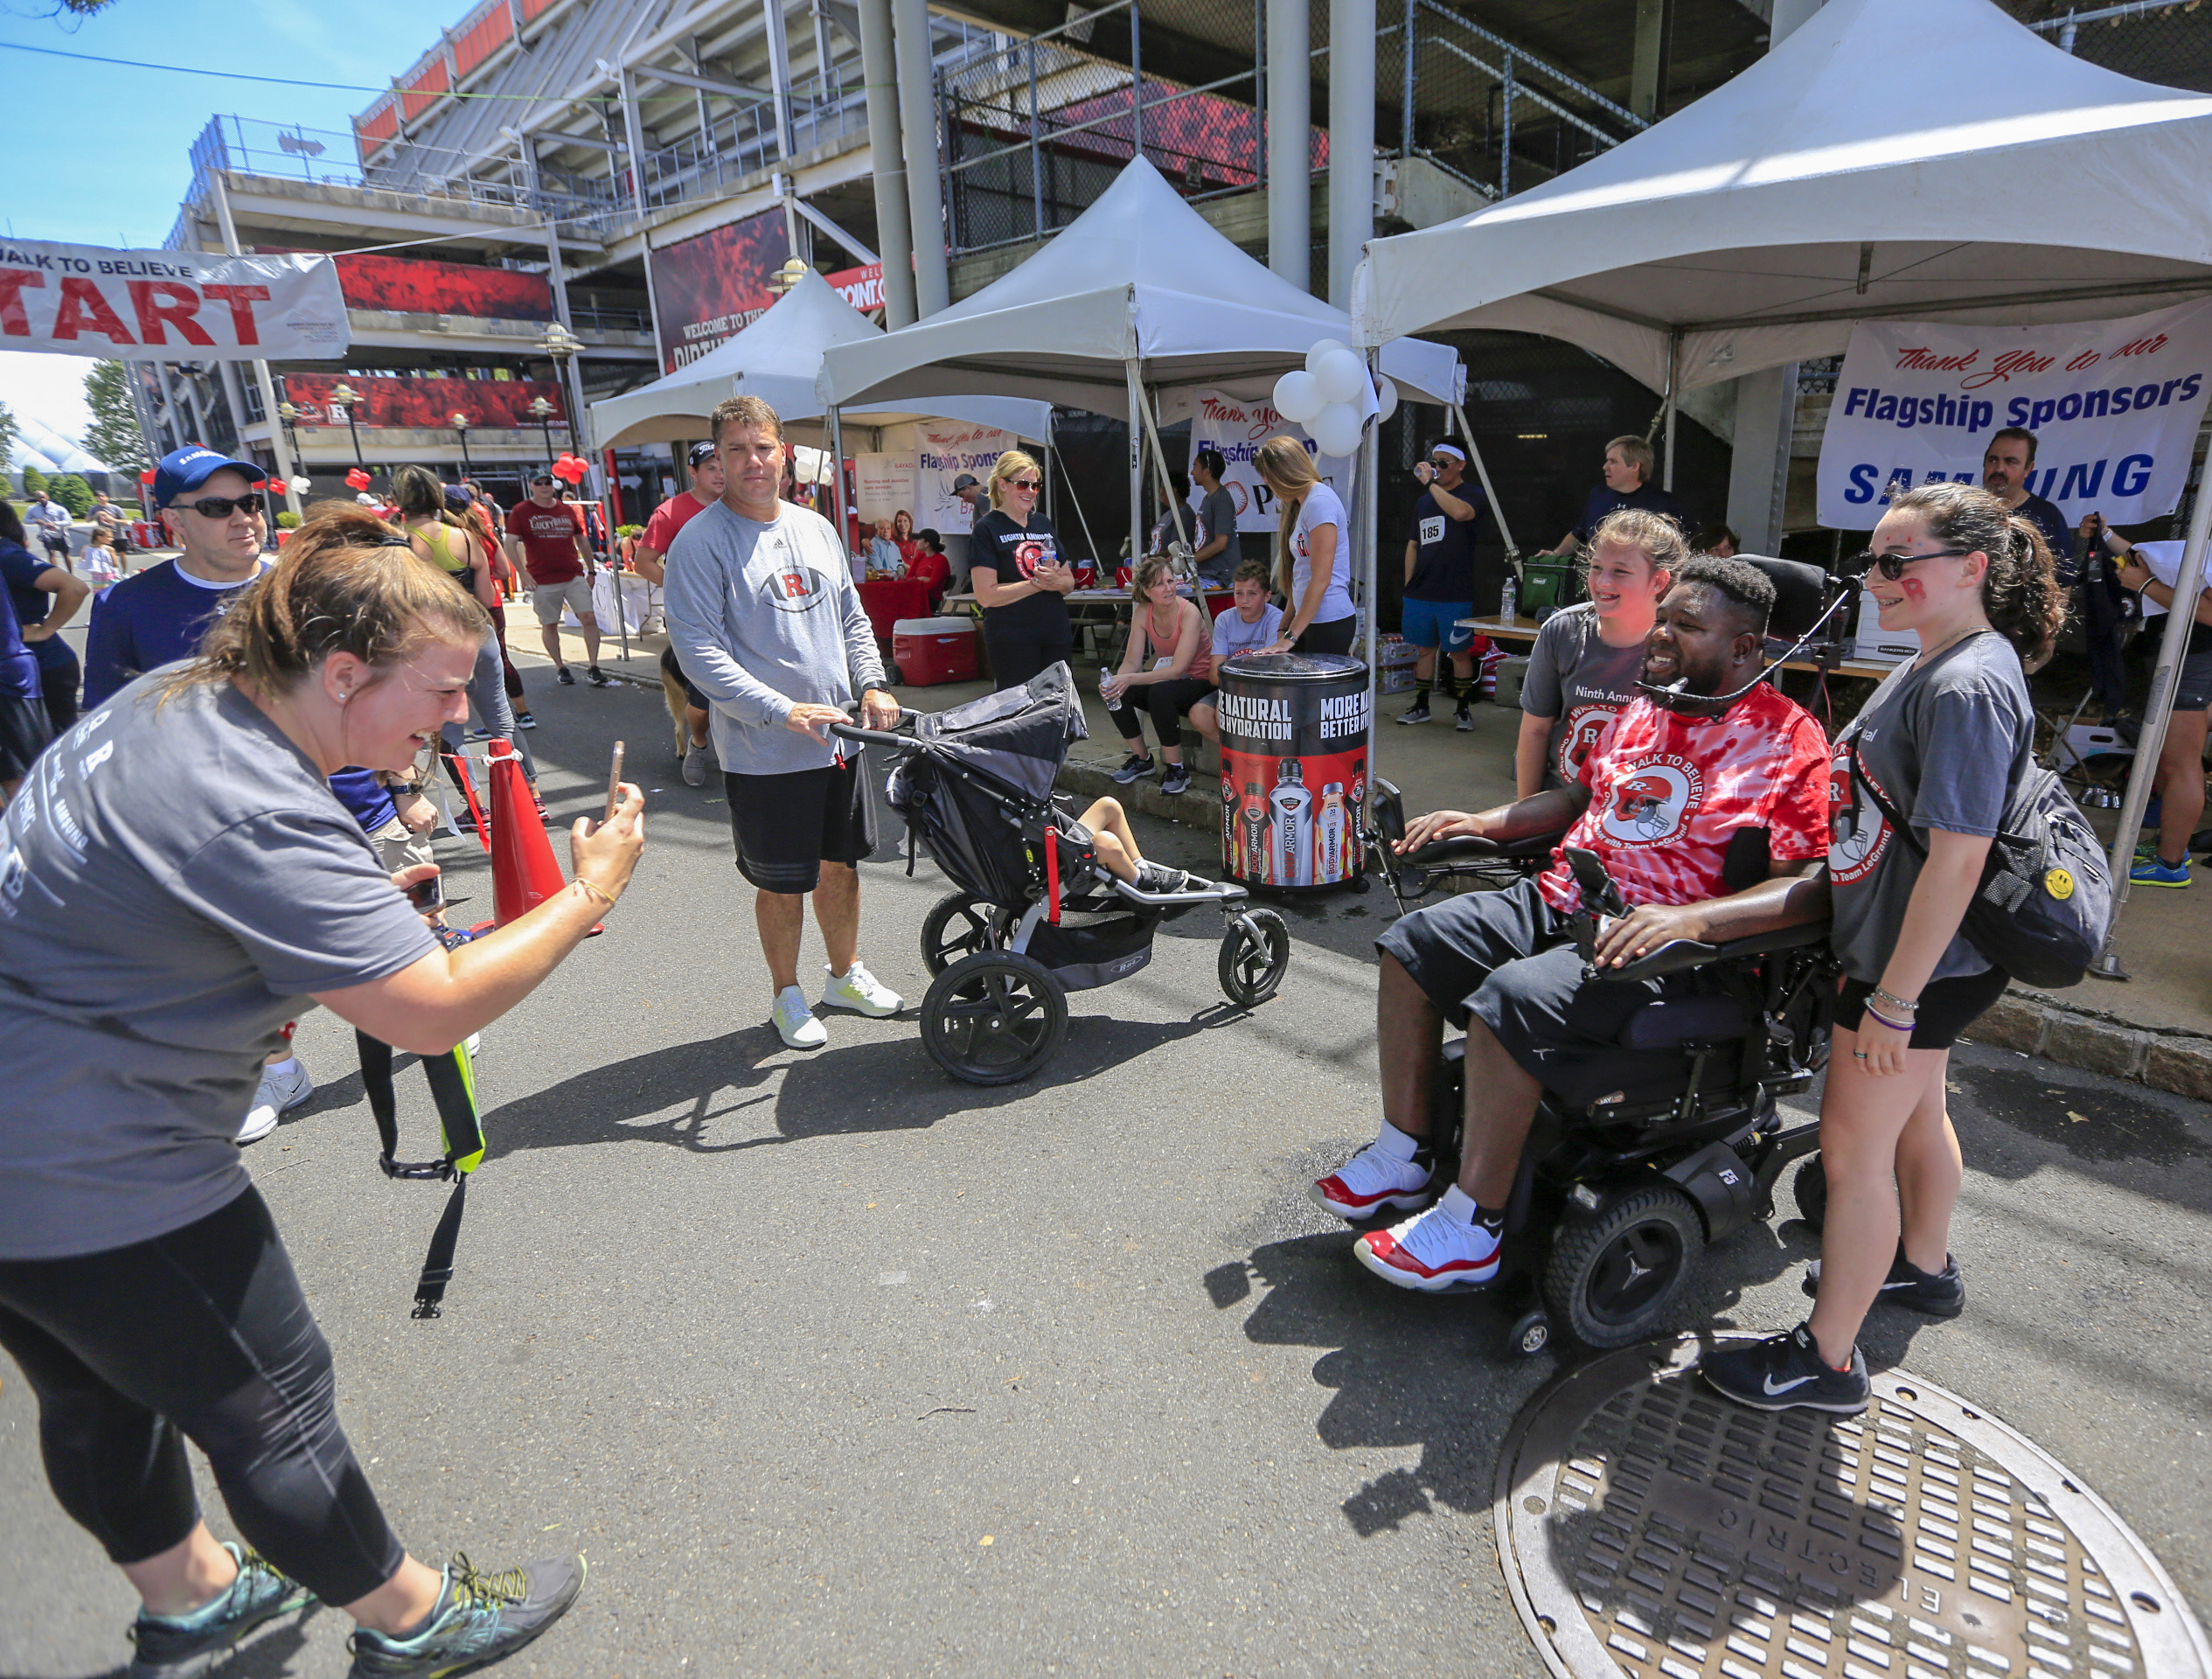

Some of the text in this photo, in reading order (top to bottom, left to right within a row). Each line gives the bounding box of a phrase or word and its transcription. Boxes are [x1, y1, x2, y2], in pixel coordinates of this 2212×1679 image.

[58, 256, 91, 273] TO
[98, 260, 193, 277] BELIEVE
[860, 266, 883, 280] WEL
[683, 316, 728, 340] WELCOME
[729, 312, 744, 330] TO
[1896, 333, 2168, 390] Thank You to our
[1200, 397, 1249, 422] Thank
[1844, 373, 2202, 433] Flagship Sponsors
[972, 428, 984, 440] to
[921, 453, 959, 471] Flagship
[1844, 454, 2153, 505] SAUNG
[999, 533, 1026, 543] EIGHTH
[1422, 525, 1439, 540] 185
[782, 574, 809, 597] R
[1576, 685, 1604, 700] Ninth
[1225, 693, 1292, 722] NATURAL
[1320, 693, 1360, 721] MORE
[1570, 704, 1599, 719] WALK
[1598, 704, 1618, 713] TO
[1226, 714, 1292, 741] HYDRATION
[1320, 715, 1360, 739] BETTER
[1582, 728, 1598, 743] R
[86, 739, 114, 775] R
[1624, 753, 1663, 773] WALK
[1666, 754, 1683, 766] TO
[1681, 762, 1703, 810] BELIEVE
[1625, 780, 1648, 791] R
[1828, 782, 1841, 802] R
[54, 798, 89, 850] SAMSUNG
[1604, 837, 1624, 848] with
[1652, 823, 1687, 847] LeGrand
[1284, 817, 1295, 878] BODYARMOR
[1840, 867, 1862, 881] Team
[1861, 829, 1892, 871] LeGrand
[1598, 1097, 1613, 1105] JAY
[1718, 1168, 1740, 1185] F5
[1718, 1507, 1941, 1615] ELECTRIC
